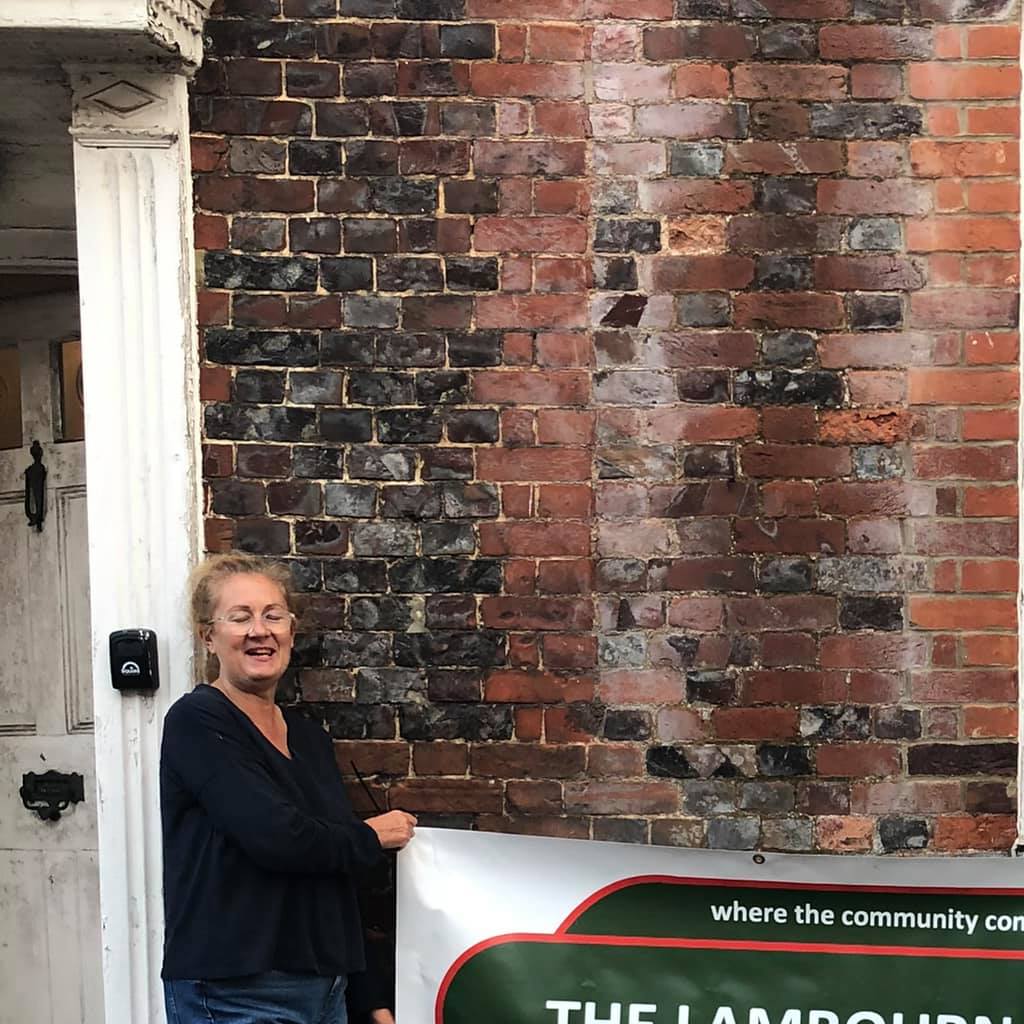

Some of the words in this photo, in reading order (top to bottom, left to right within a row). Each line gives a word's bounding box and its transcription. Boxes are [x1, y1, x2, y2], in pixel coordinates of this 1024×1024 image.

[710, 900, 788, 924] where
[794, 902, 835, 925] the
[841, 907, 979, 935] community
